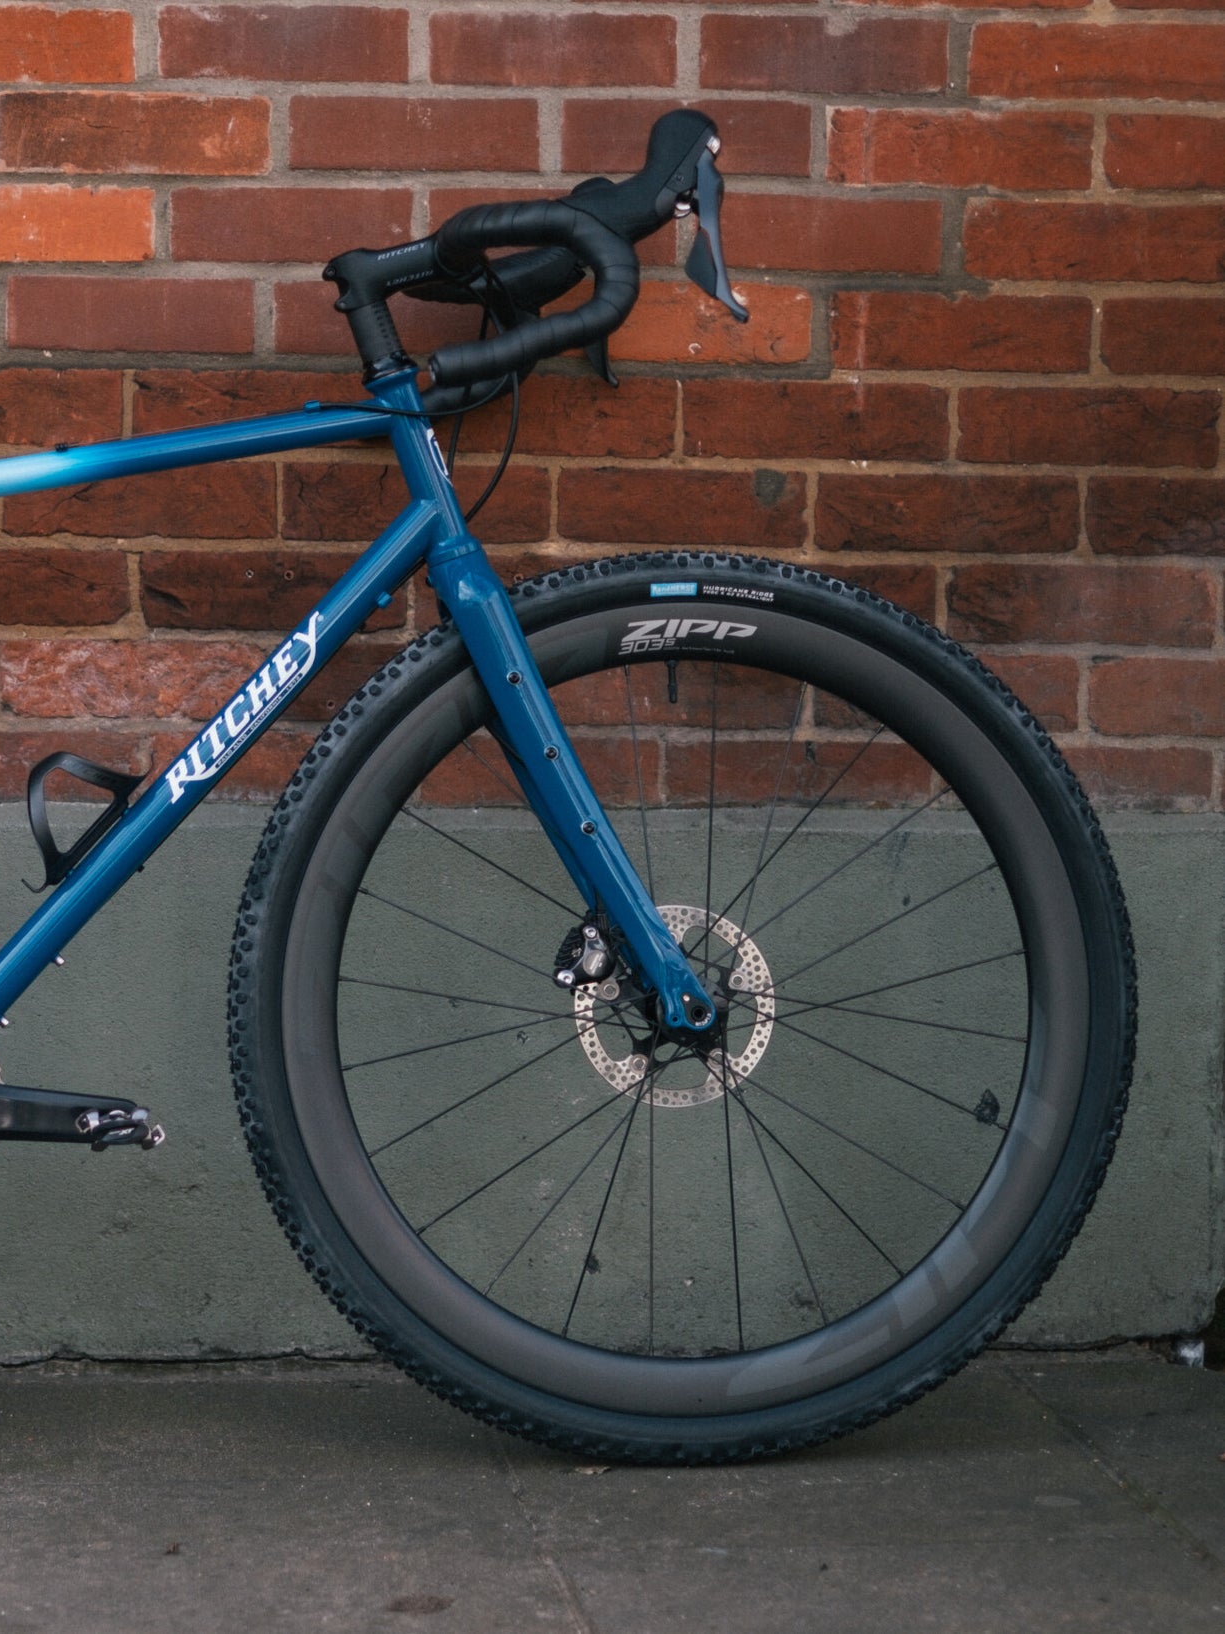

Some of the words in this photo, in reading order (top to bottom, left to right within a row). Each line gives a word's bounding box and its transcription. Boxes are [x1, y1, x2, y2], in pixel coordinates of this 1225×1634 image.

[377, 241, 428, 261] RITCHEY
[702, 585, 749, 595] HURRICANE
[751, 589, 774, 598] RIDGE
[621, 618, 758, 643] ZIPP
[165, 611, 319, 804] RITCHEY
